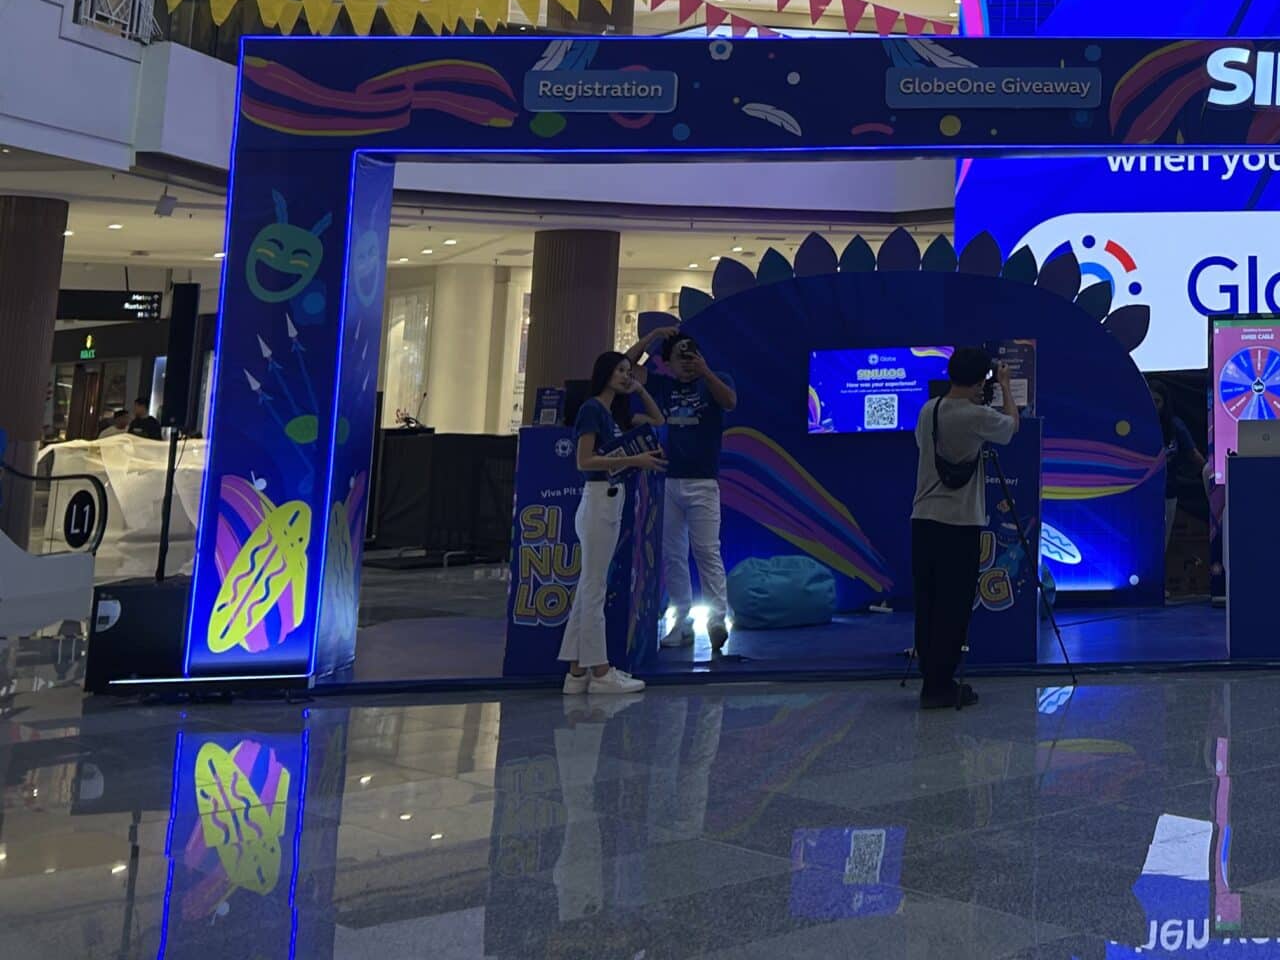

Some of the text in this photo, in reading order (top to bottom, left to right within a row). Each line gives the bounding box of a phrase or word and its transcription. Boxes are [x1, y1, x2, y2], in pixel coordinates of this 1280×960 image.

[538, 79, 663, 101] Registration
[899, 76, 1092, 98] GlobeOne Giveaway
[1107, 152, 1208, 172] when
[540, 487, 562, 498] Viva
[563, 486, 577, 496] Pit
[984, 475, 1019, 488] Senor!
[70, 503, 90, 534] L1
[519, 504, 562, 545] SI
[513, 580, 577, 627] LO
